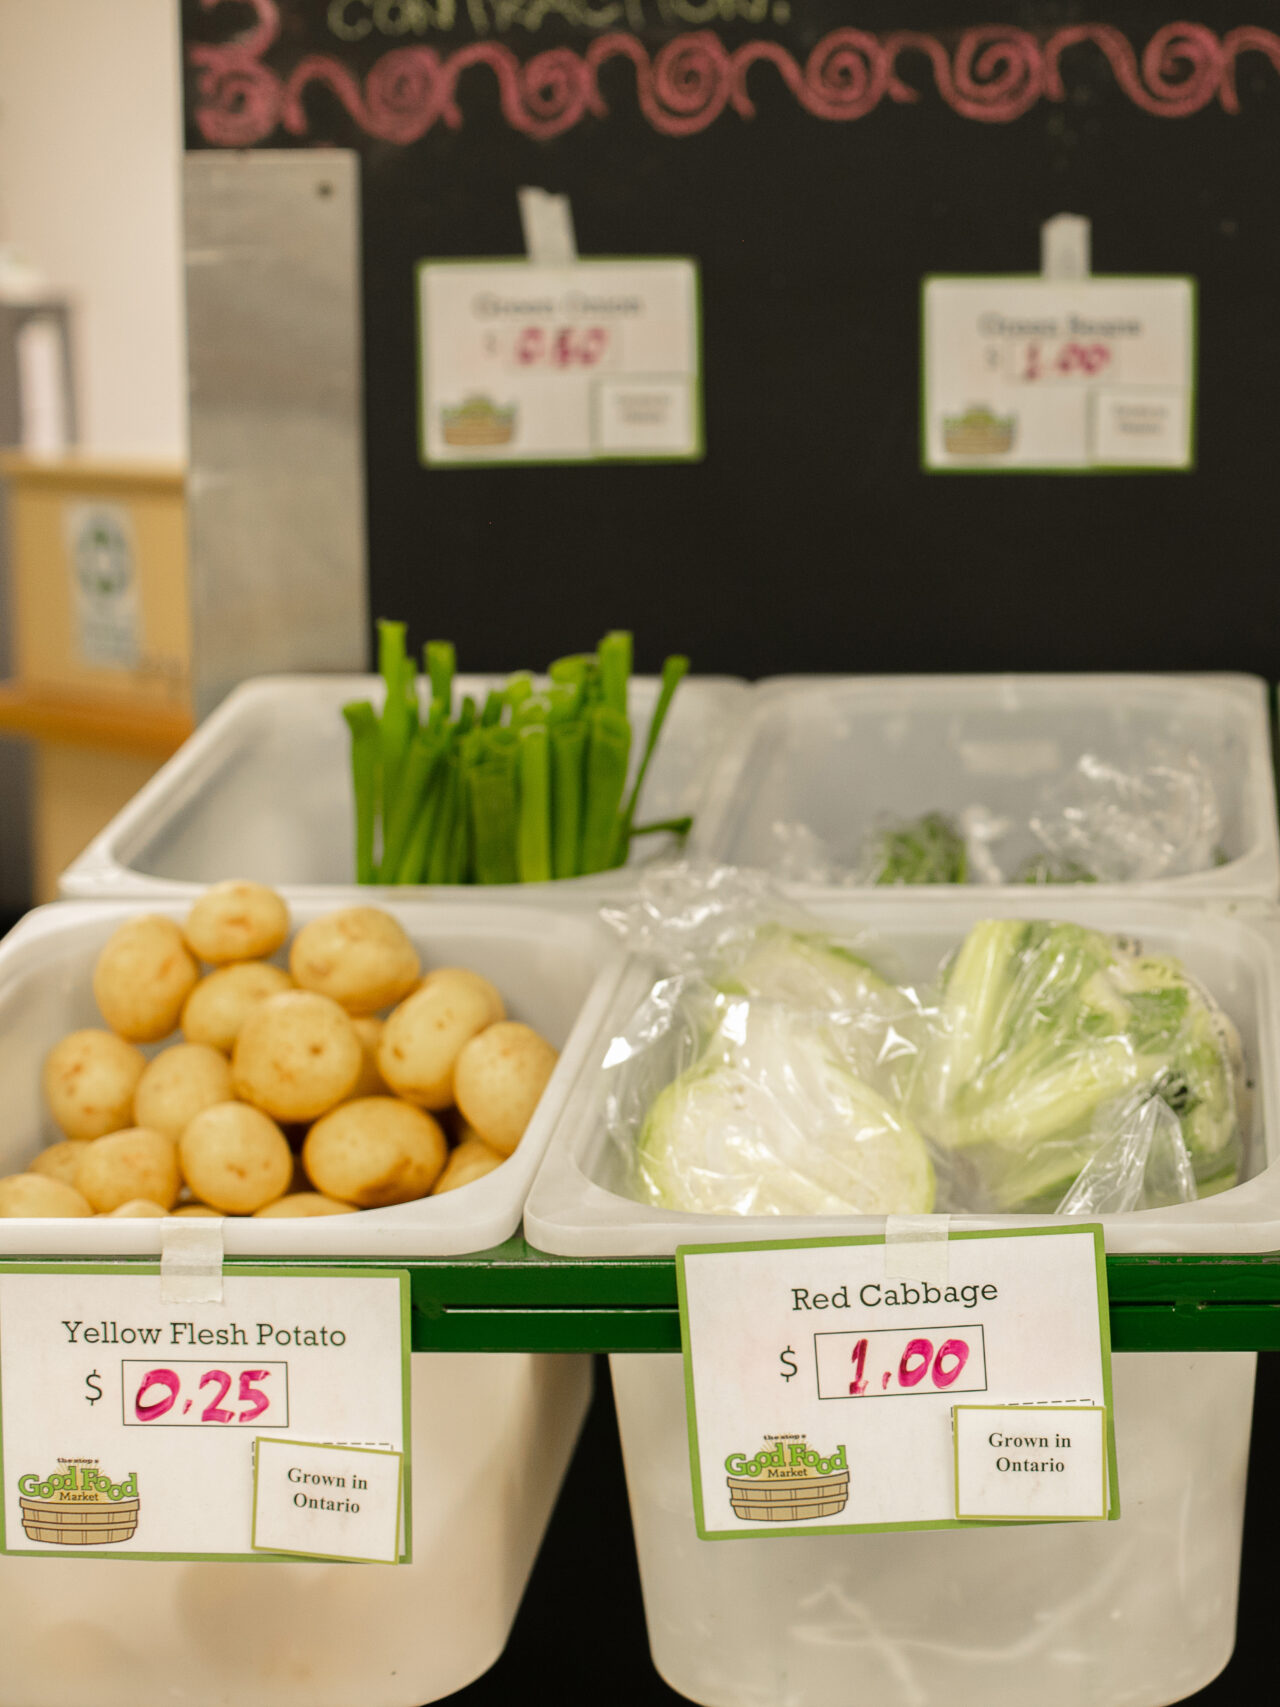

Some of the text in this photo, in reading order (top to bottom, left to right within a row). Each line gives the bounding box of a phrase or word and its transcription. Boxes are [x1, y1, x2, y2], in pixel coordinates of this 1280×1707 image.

[791, 1280, 999, 1311] Red Cabbage
[62, 1320, 347, 1347] Yellow Flesh Potato
[779, 1337, 970, 1397] $ 1.00
[85, 1368, 272, 1424] $ 0.25
[988, 1432, 1071, 1449] Grown in
[724, 1442, 849, 1477] Good Food
[767, 1467, 808, 1478] Market
[996, 1456, 1065, 1474] Ontario
[18, 1466, 140, 1501] Good Food
[287, 1466, 368, 1491] Grown in
[59, 1491, 99, 1502] Market
[293, 1492, 361, 1514] Ontario
